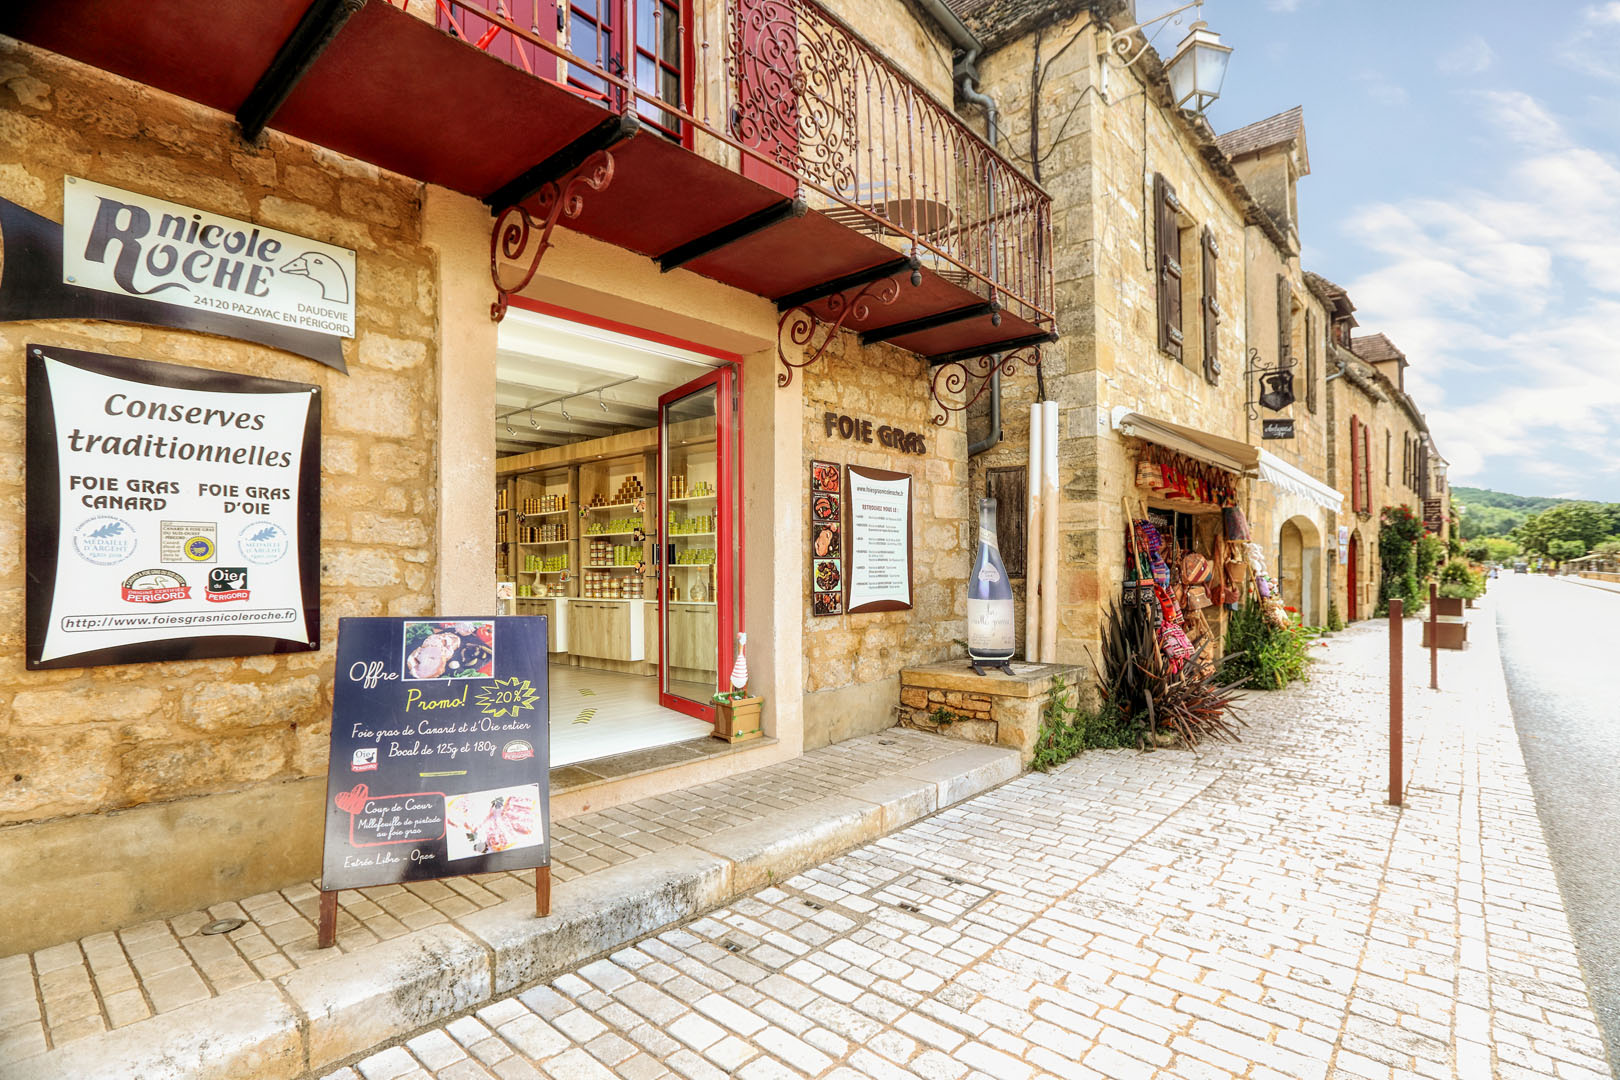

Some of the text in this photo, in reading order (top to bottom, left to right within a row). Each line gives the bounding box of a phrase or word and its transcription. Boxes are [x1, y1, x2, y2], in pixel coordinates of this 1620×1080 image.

[158, 213, 282, 262] nicole
[193, 295, 352, 335] 24120 PAZAYAC EN PÉRIGORD
[298, 303, 349, 321] DAUDEVIE
[104, 393, 266, 431] Conserves
[824, 411, 927, 456] FOIE GRAS
[67, 428, 292, 468] traditionnelles
[70, 475, 180, 495] FOIE GRAS
[198, 483, 291, 501] FOIE GRAS
[81, 494, 167, 512] CANARD
[224, 501, 271, 515] D'OIE
[211, 569, 238, 581] Oie
[127, 592, 186, 602] PERIGORD
[208, 592, 248, 601] PERIGORD
[65, 611, 295, 629] http://www.foiesgrasnicoleroche.fr
[349, 661, 399, 689] Offre
[405, 684, 469, 713] Promo!
[351, 717, 532, 743] Foie gras de Canard et d'Oie entier
[388, 740, 497, 759] Bocal de 125g et 180g
[365, 798, 433, 817] Coup de Coeur
[358, 815, 442, 832] Millefeuille de pintade
[387, 827, 404, 840] foie
[404, 828, 422, 839] gras
[343, 855, 374, 868] Entrée
[376, 852, 401, 865] Libre
[410, 849, 436, 864] Open
